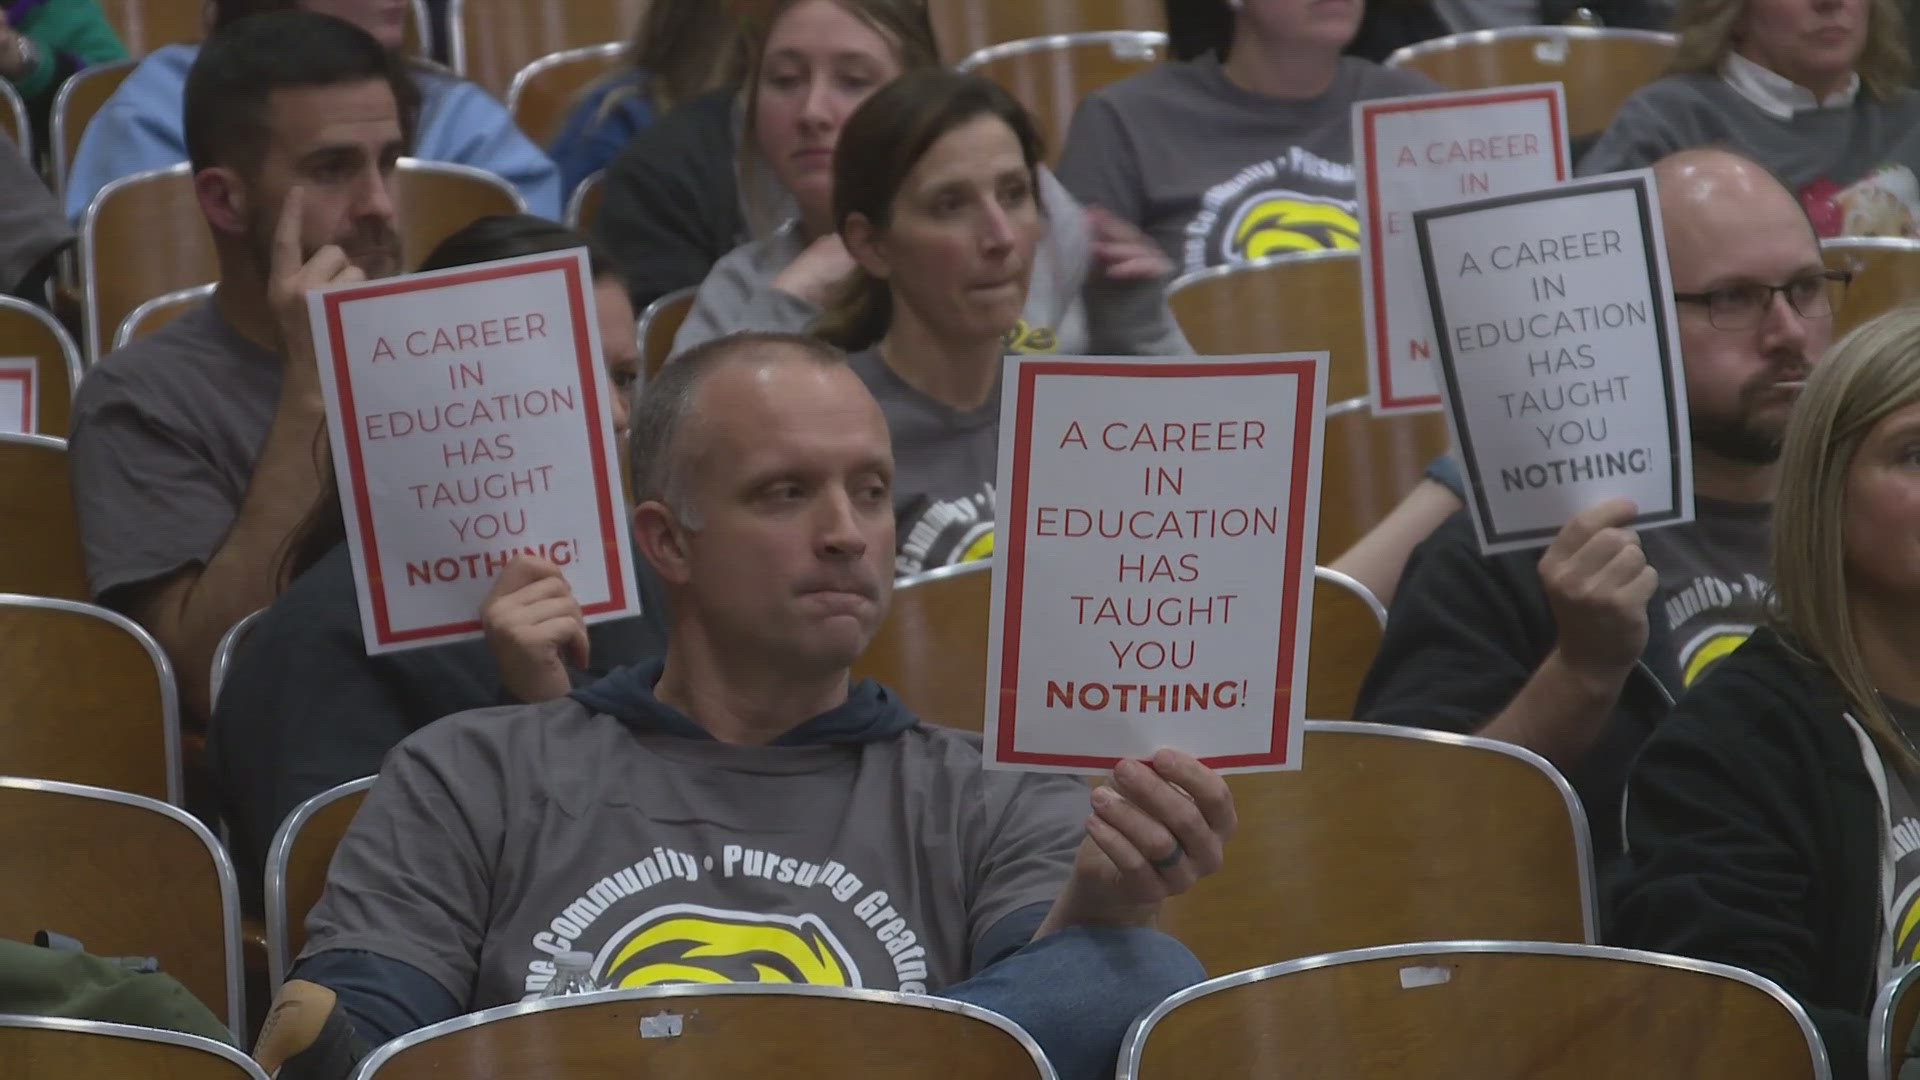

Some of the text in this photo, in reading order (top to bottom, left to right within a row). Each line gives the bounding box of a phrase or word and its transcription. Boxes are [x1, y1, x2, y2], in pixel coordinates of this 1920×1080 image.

[1397, 133, 1538, 168] A CAREER
[1460, 172, 1490, 195] IN
[1459, 229, 1622, 277] A CAREER
[1532, 273, 1567, 302] IN
[371, 312, 547, 363] A CAREER
[1456, 300, 1648, 353] EDUCATION
[448, 360, 484, 391] IN
[1528, 343, 1597, 378] HAS
[364, 385, 575, 441] EDUCATION
[1498, 375, 1631, 419] TAUGHT
[441, 433, 515, 468] HAS
[1059, 420, 1266, 452] A CAREER
[1536, 417, 1608, 450] YOU
[408, 464, 554, 510] TAUGHT
[1144, 466, 1183, 496] IN
[1501, 447, 1654, 493] NOTHING!
[448, 508, 527, 542] YOU
[1036, 506, 1278, 540] EDUCATION
[405, 538, 579, 587] NOTHG!
[1118, 553, 1200, 583] HAS
[1070, 594, 1238, 627] TAUGHT
[1665, 575, 1732, 630] unity
[1109, 640, 1195, 670] YOU
[1046, 680, 1248, 713] NOTHING!
[532, 846, 699, 957] Community
[723, 844, 864, 902] Pursung
